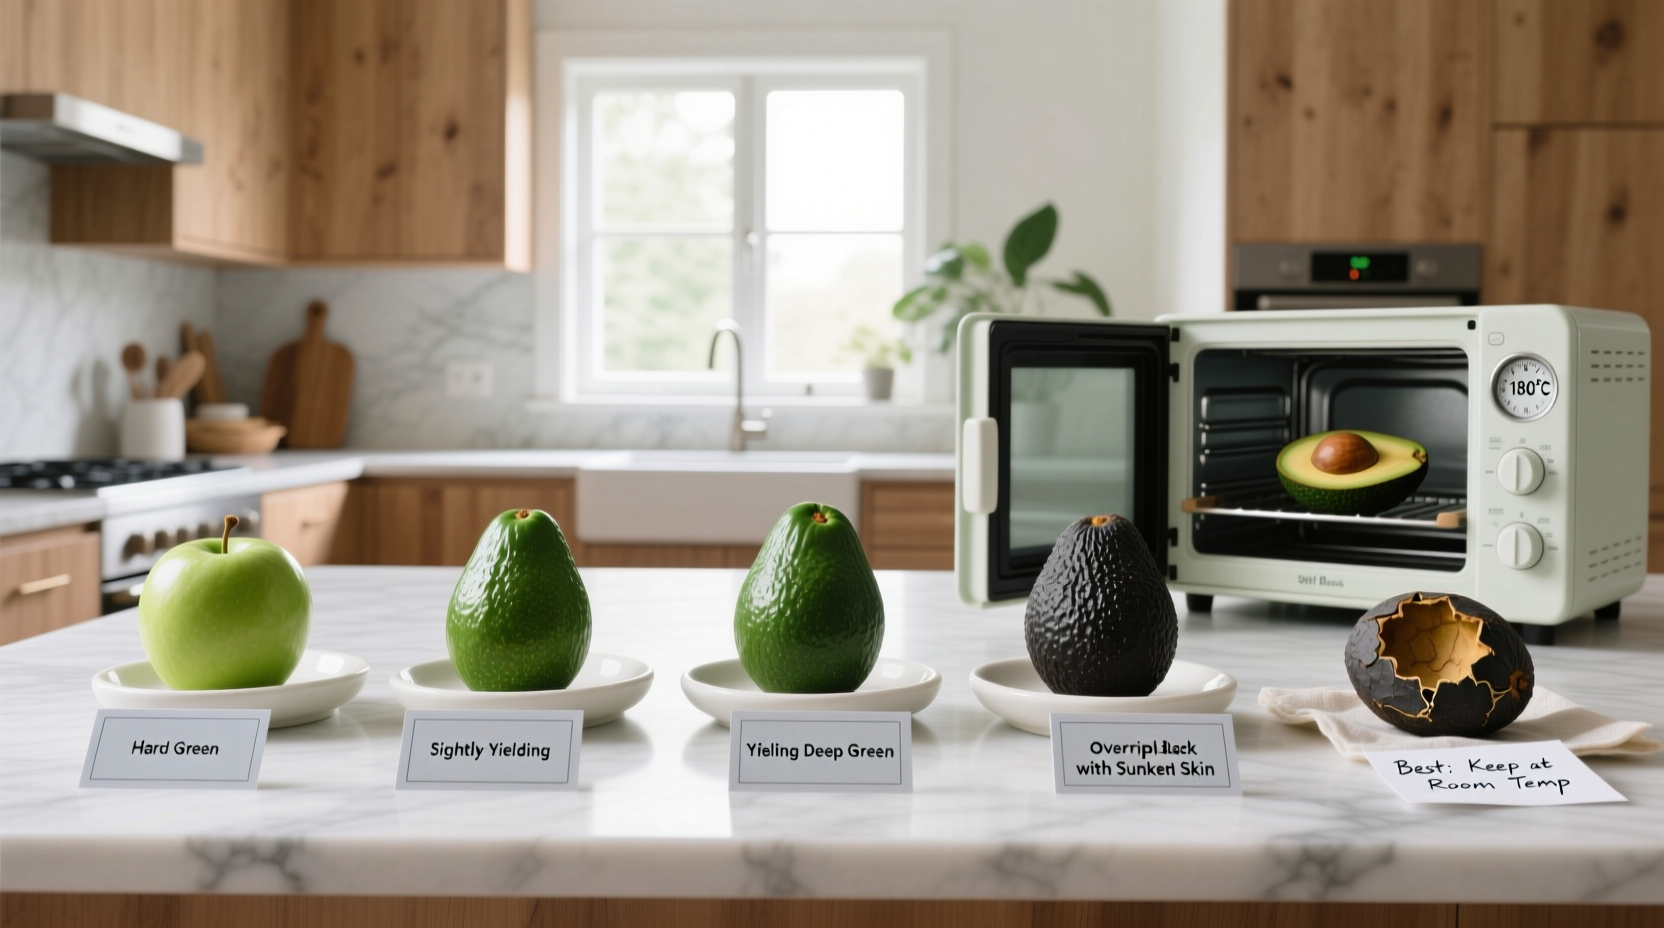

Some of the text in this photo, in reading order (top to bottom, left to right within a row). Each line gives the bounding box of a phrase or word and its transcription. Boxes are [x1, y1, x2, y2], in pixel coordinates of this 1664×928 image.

[131, 739, 219, 756] Hard Green
[430, 740, 551, 762] Sightly Yielding
[746, 742, 895, 762] Yieling Deep Green
[1075, 759, 1112, 776] with
[1180, 760, 1215, 777] Skin
[1393, 757, 1553, 776] Best: Keep at
[1427, 774, 1571, 796] Room Temp
